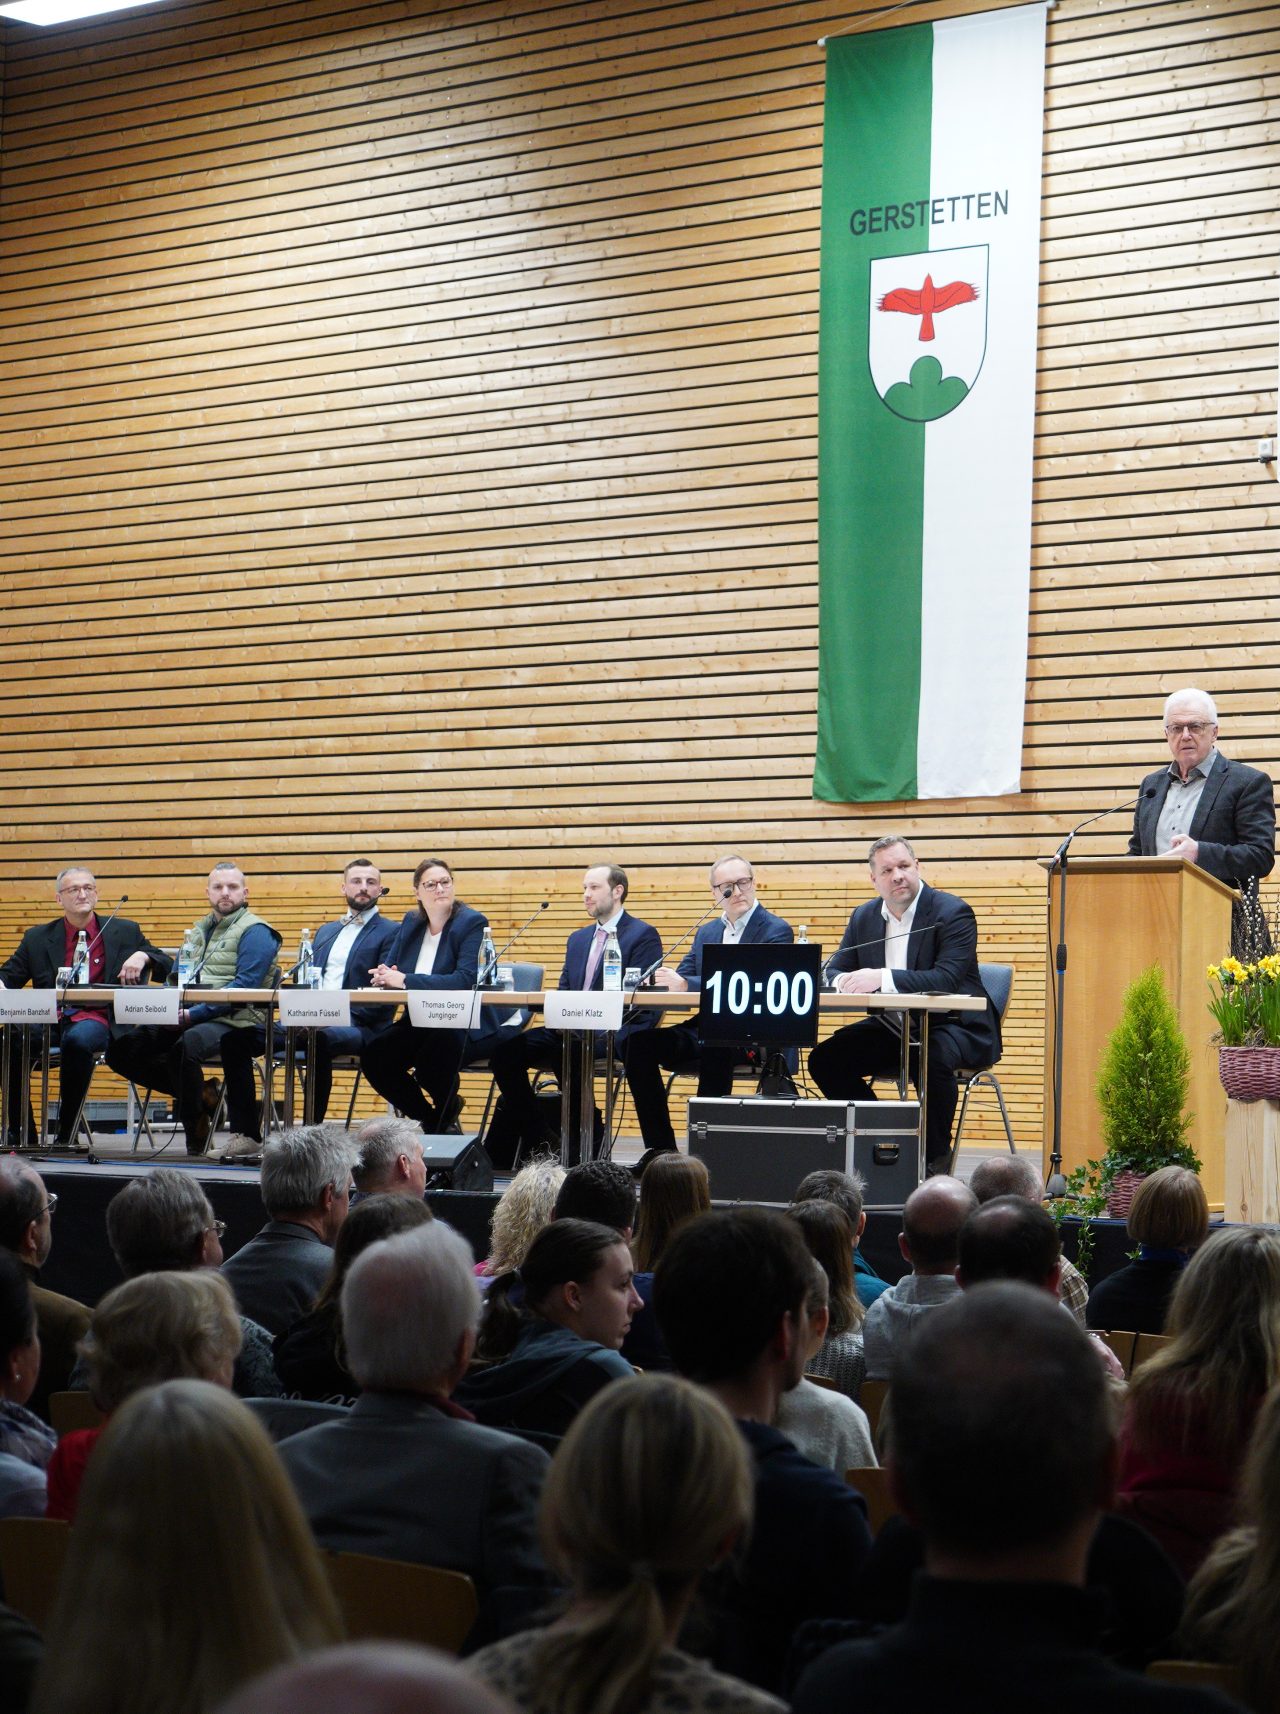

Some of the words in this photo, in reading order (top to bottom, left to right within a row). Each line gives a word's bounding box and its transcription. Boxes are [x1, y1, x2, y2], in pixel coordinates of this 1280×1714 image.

[850, 190, 1009, 236] GERSTETTEN
[706, 970, 814, 1016] 10:00
[124, 1005, 144, 1013] Adrian
[145, 1005, 167, 1013] Seibold
[421, 1001, 445, 1009] Thomas
[446, 1001, 465, 1010] Georg
[0, 1008, 27, 1017] Benjamin
[28, 1008, 51, 1016] Banzhaf
[287, 1009, 318, 1017] Katharina
[319, 1009, 341, 1017] Füssel
[428, 1011, 458, 1020] Junginger
[561, 1008, 584, 1017] Daniel
[585, 1008, 603, 1018] Klatz
